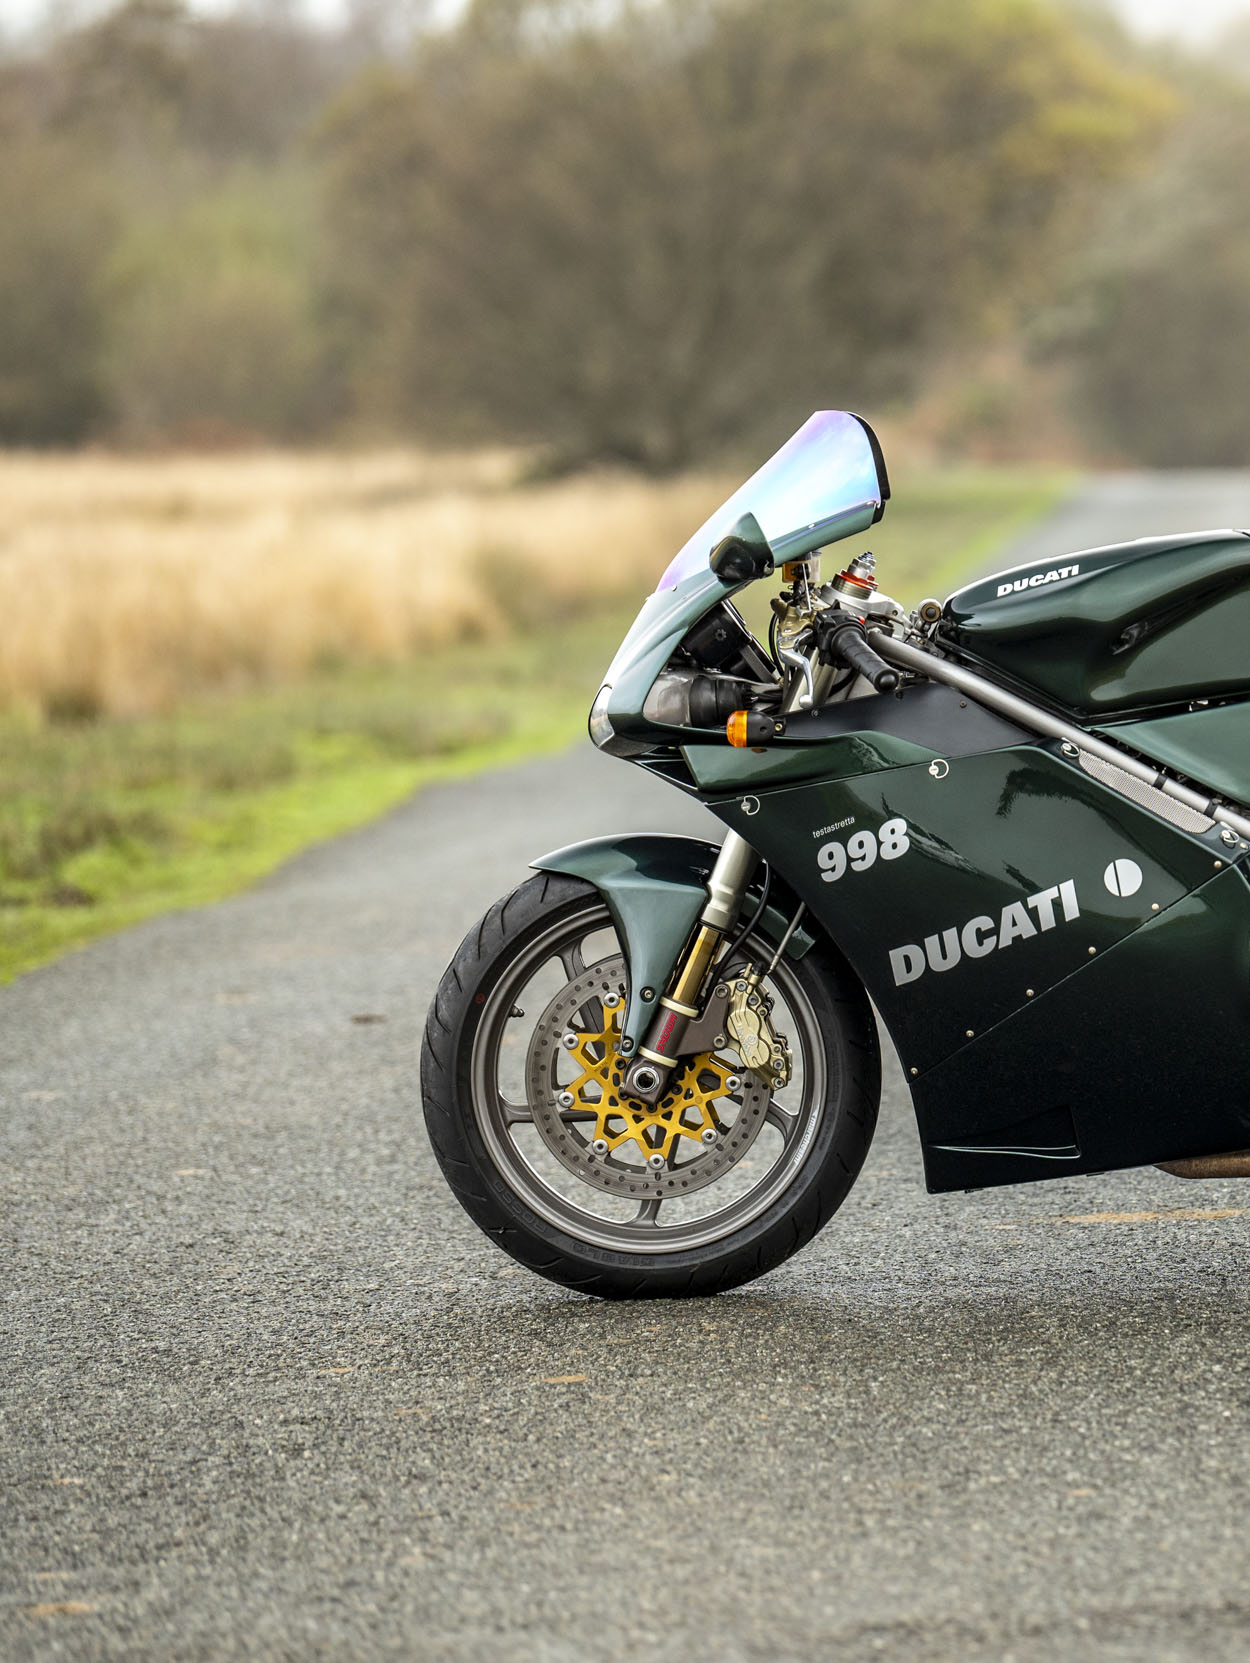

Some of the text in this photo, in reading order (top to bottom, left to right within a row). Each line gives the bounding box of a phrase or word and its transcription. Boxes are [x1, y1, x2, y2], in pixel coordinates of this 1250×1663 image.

[996, 564, 1080, 597] DUCATI
[812, 816, 856, 838] testastretta
[817, 818, 910, 883] 998
[888, 878, 1081, 987] DUCATI
[656, 1012, 677, 1054] SHOWA
